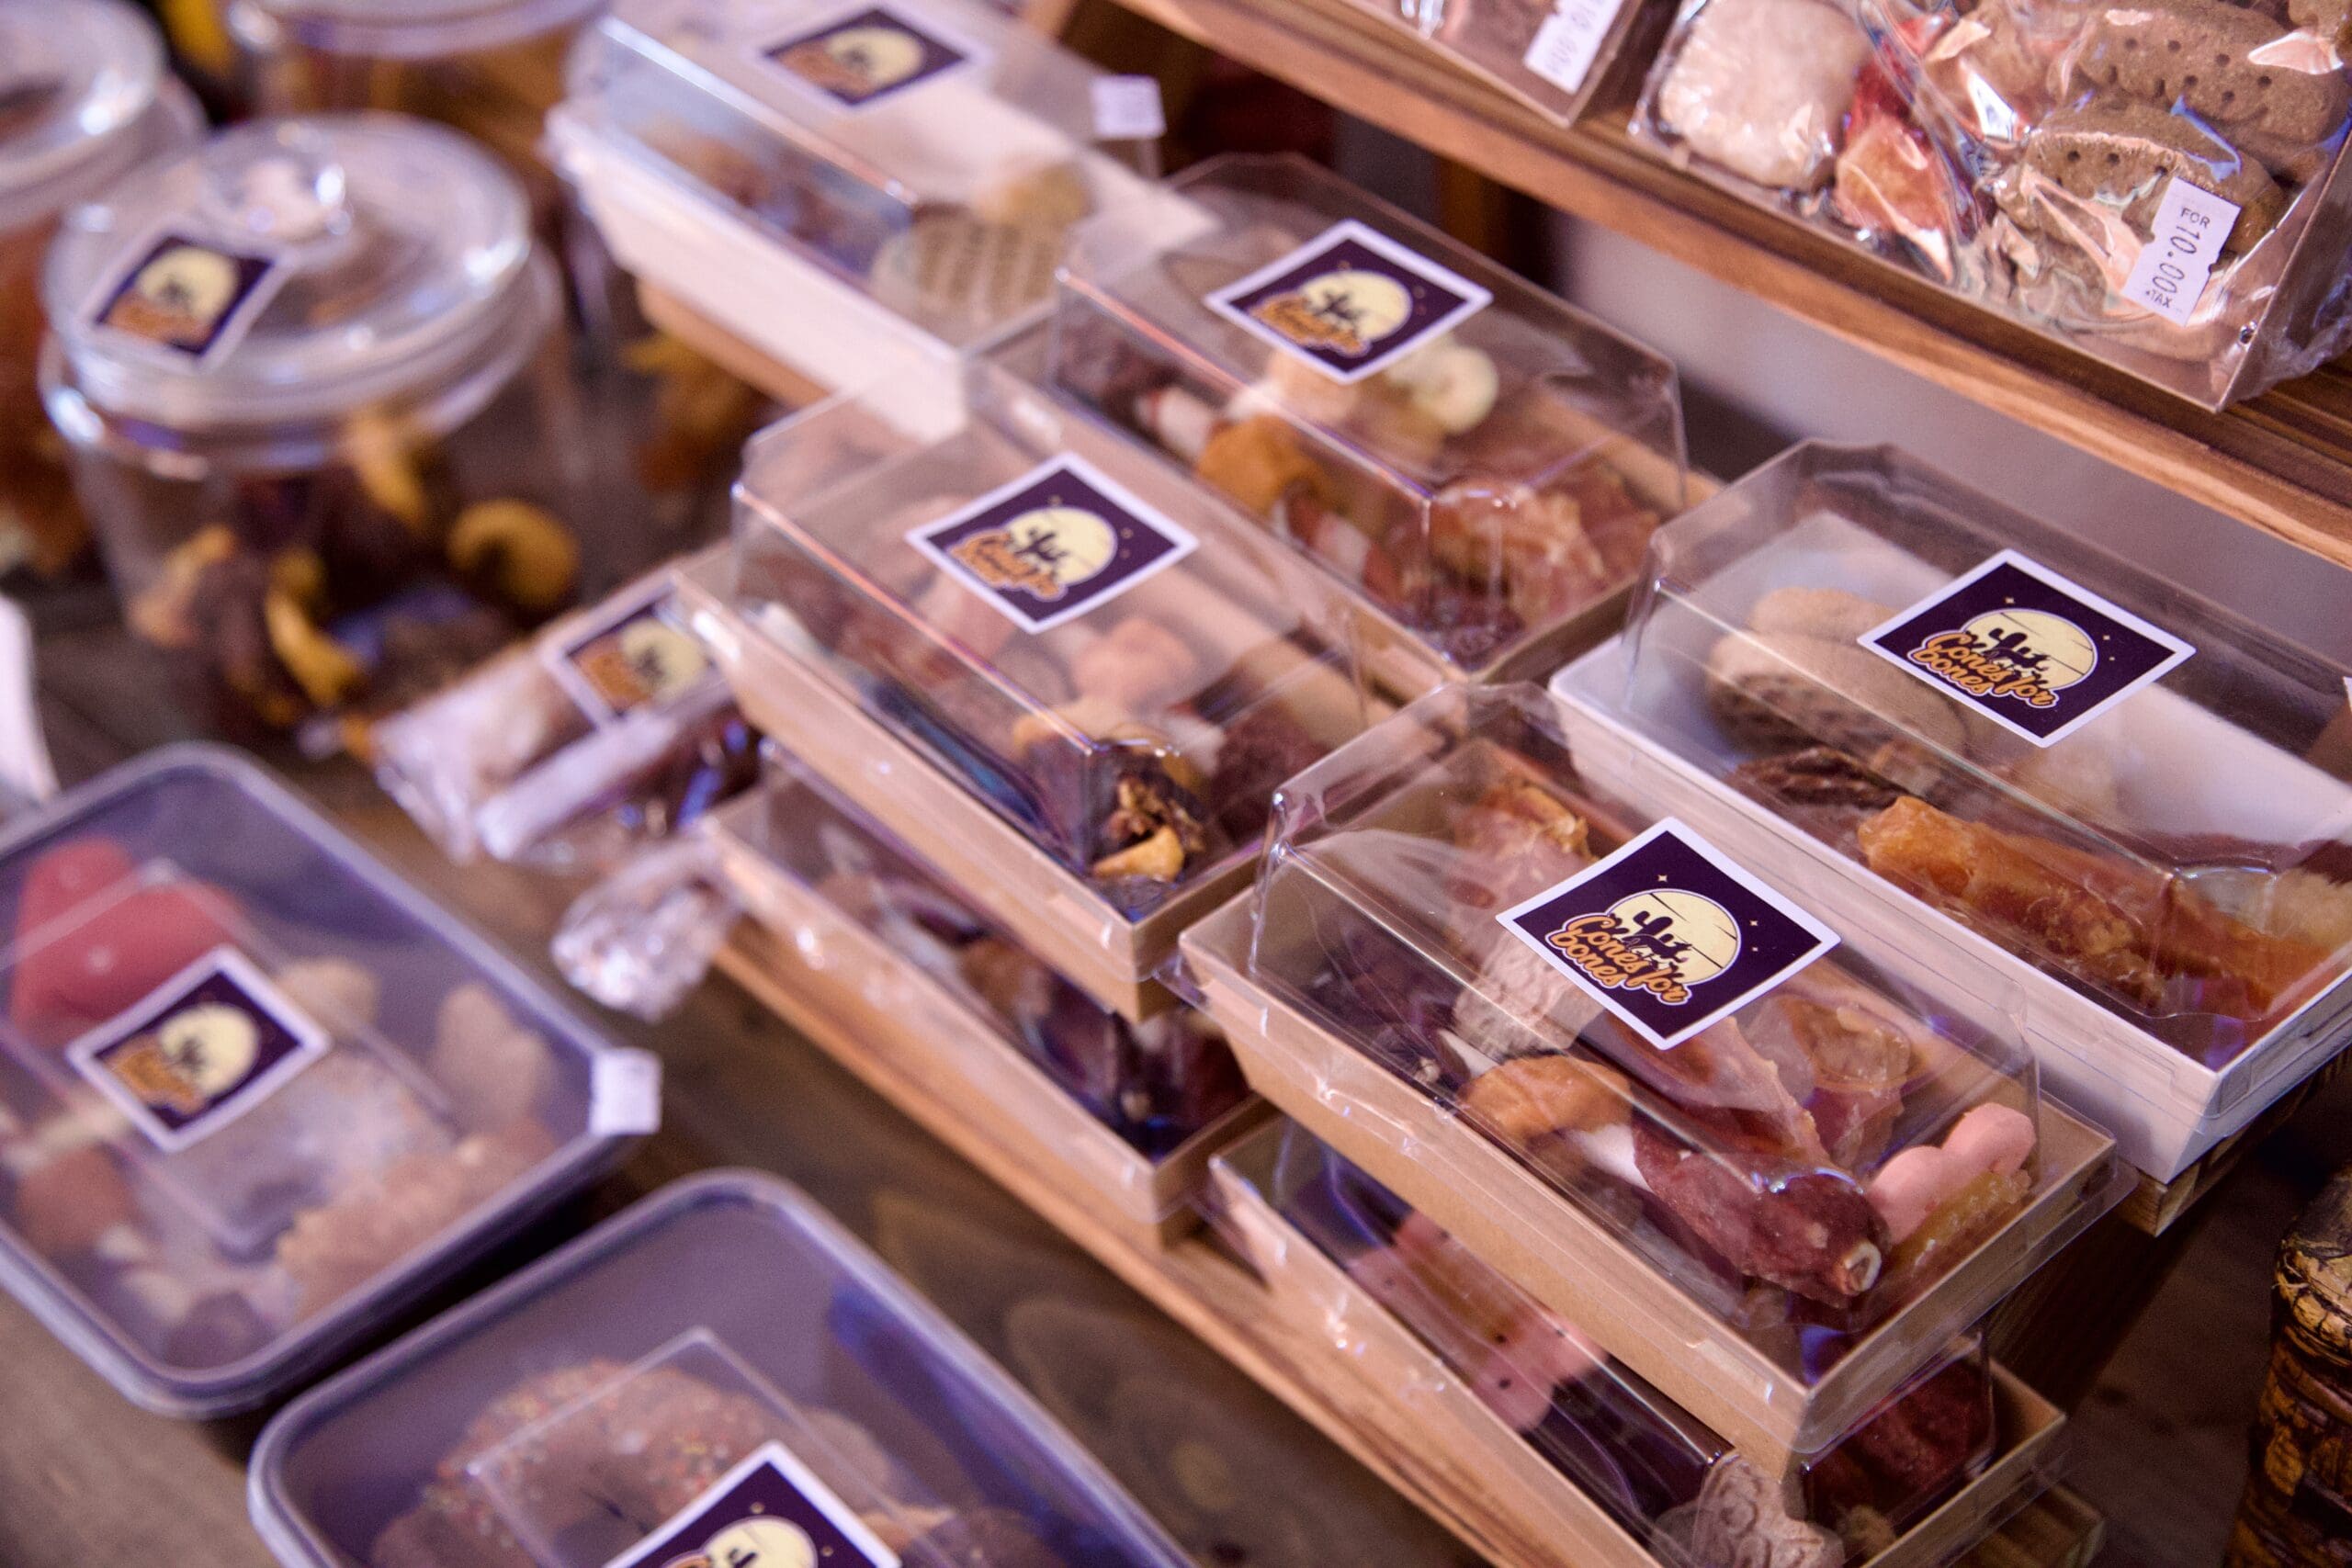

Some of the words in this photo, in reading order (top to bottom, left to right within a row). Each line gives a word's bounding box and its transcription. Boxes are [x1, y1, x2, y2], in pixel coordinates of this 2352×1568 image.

[2180, 208, 2211, 229] FOR
[2153, 225, 2200, 294] 10.00
[1913, 645, 1994, 694] bones
[1928, 633, 2015, 682] Cones
[1993, 675, 2054, 706] for
[1551, 928, 1629, 987] bones
[1566, 915, 1653, 974] Cones
[1624, 966, 1688, 1003] for
